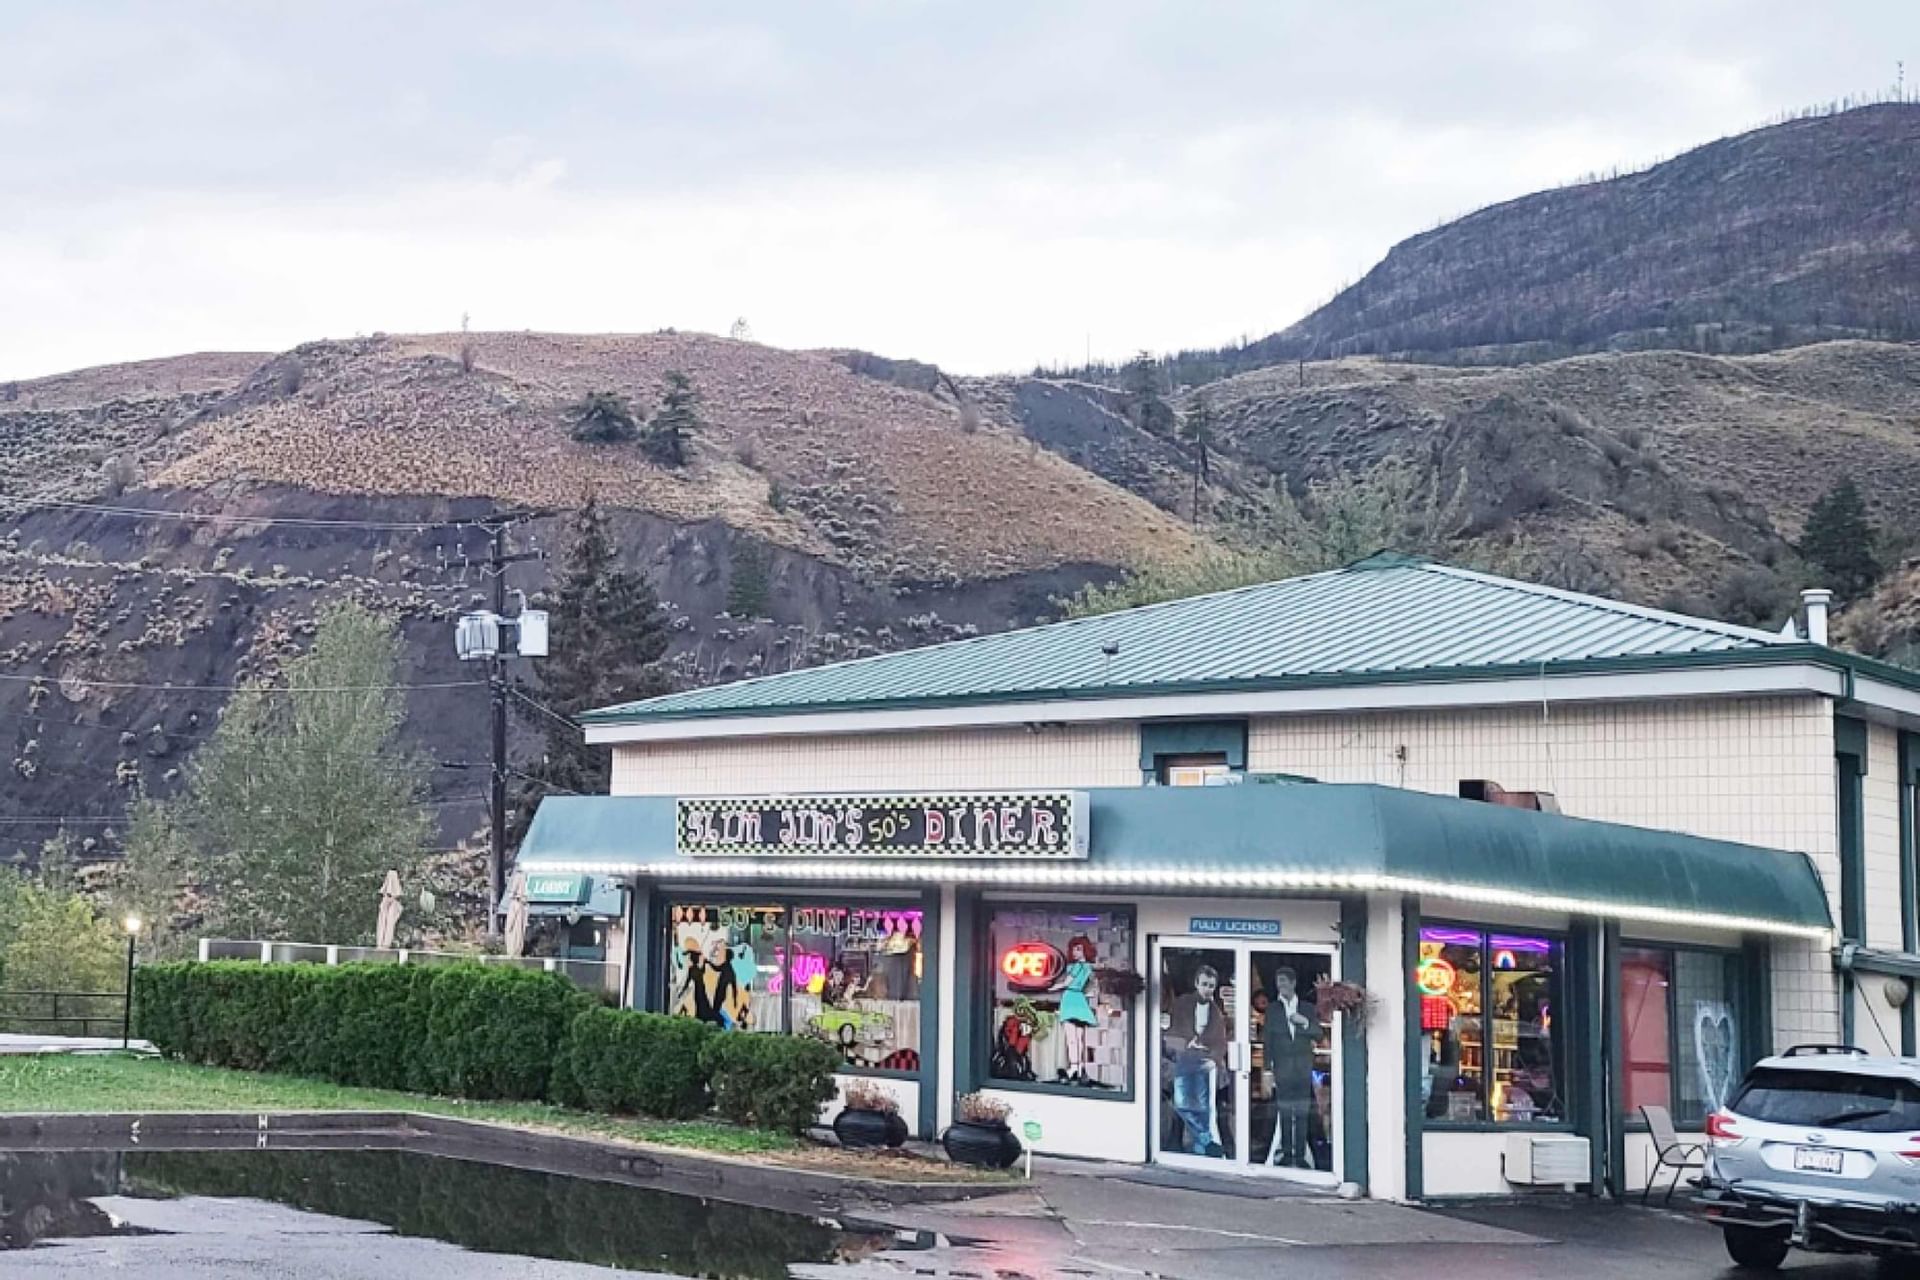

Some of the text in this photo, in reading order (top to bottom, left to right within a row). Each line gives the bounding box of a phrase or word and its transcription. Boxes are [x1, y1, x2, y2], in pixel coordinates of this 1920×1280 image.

[1192, 919, 1278, 933] FULLY LICENSED
[1003, 952, 1054, 977] OPE
